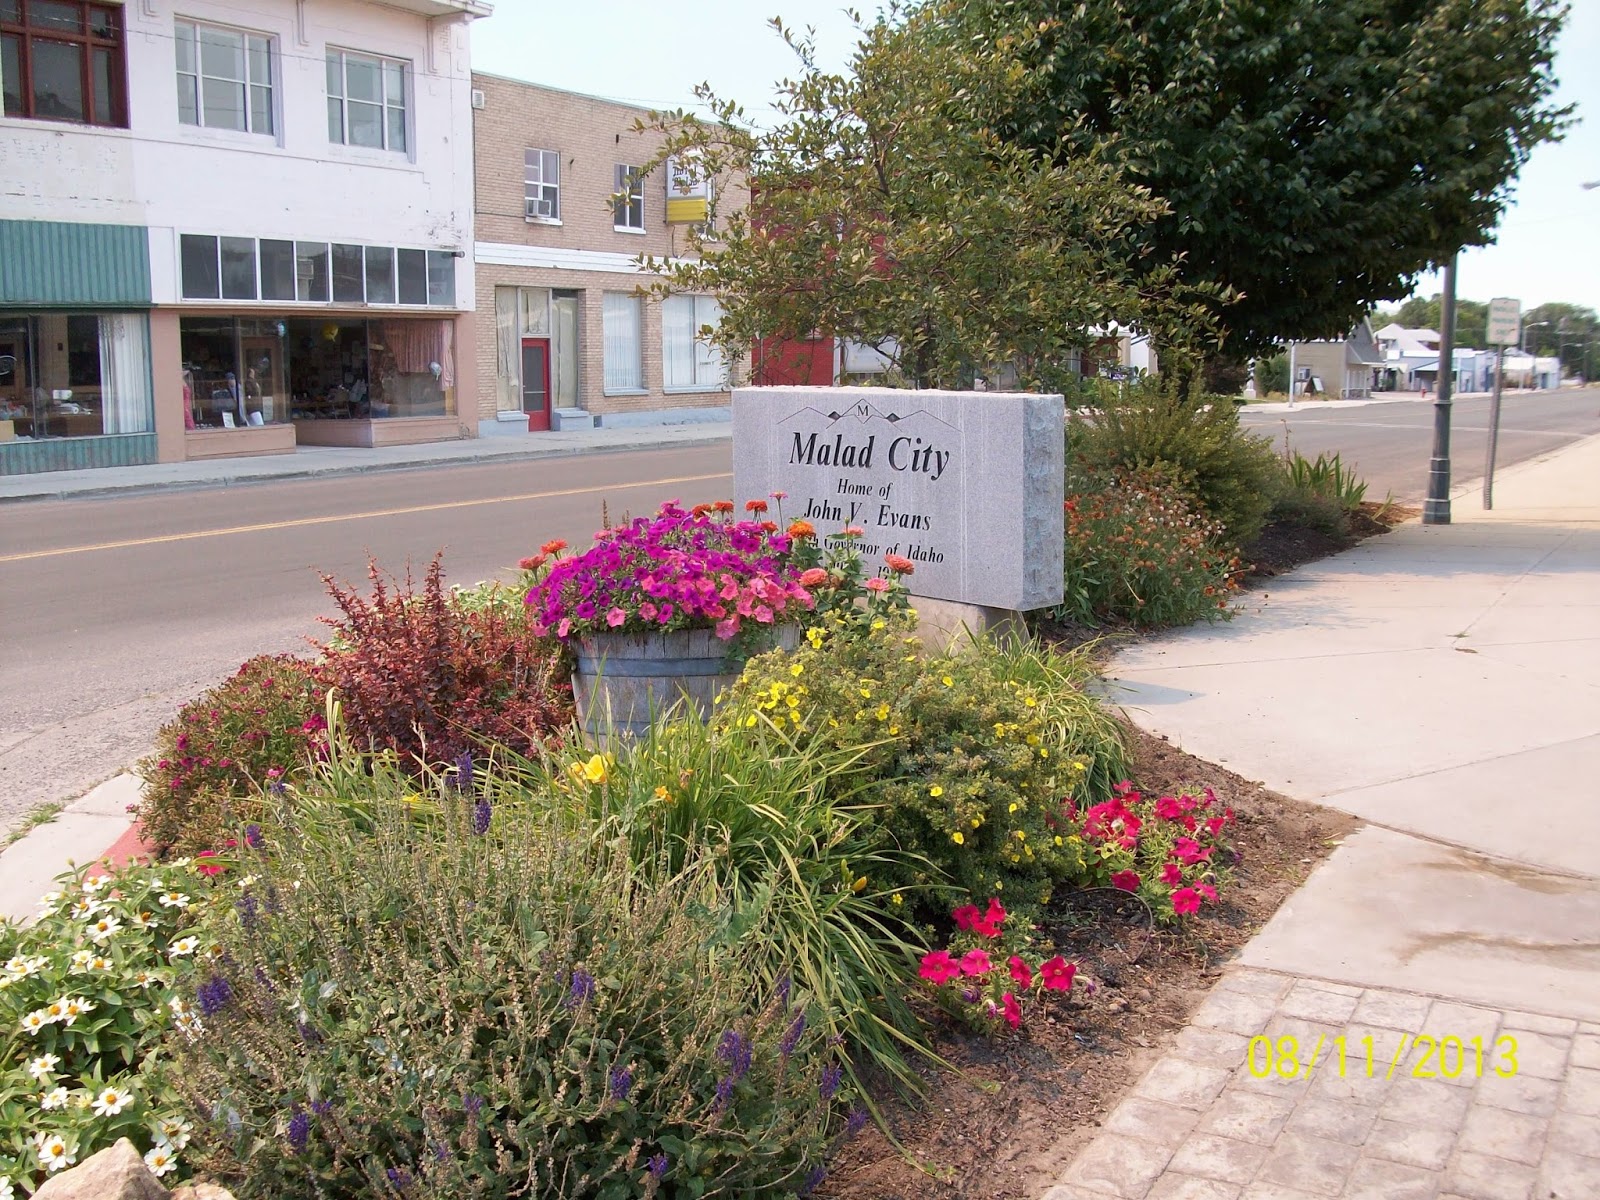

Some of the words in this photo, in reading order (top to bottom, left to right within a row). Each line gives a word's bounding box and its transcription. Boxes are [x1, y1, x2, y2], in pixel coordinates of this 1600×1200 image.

[857, 405, 869, 417] M
[789, 432, 875, 468] Malad
[888, 436, 950, 481] City
[837, 478, 873, 496] Home
[879, 482, 894, 500] of
[804, 498, 842, 522] John
[850, 502, 868, 525] V.
[877, 504, 931, 531] Evans
[886, 543, 901, 556] of
[907, 544, 944, 564] Idaho
